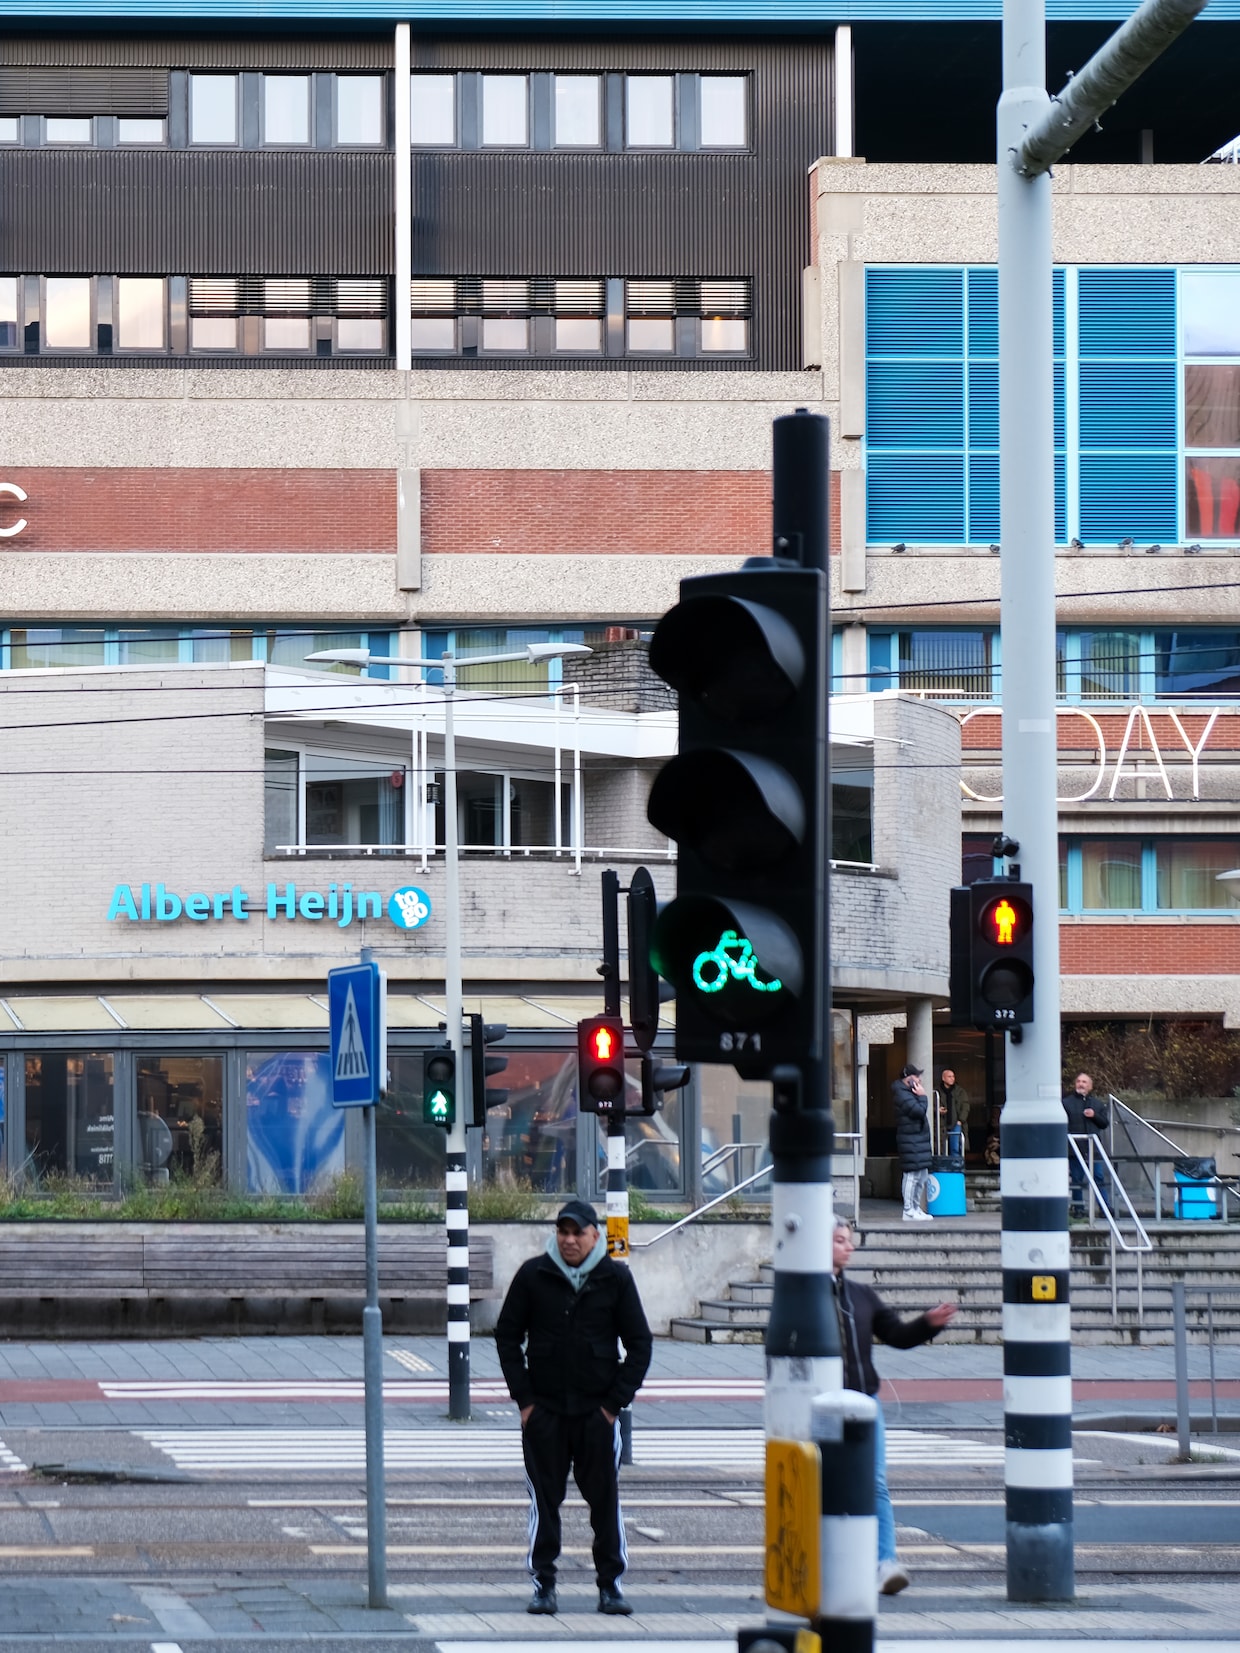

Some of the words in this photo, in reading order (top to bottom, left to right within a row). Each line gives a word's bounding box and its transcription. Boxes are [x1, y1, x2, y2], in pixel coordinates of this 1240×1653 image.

[106, 883, 249, 921] Albert
[267, 883, 382, 928] Heijn
[394, 890, 419, 910] to
[401, 902, 429, 928] go
[994, 1009, 1016, 1019] 372
[720, 1032, 761, 1051] 871
